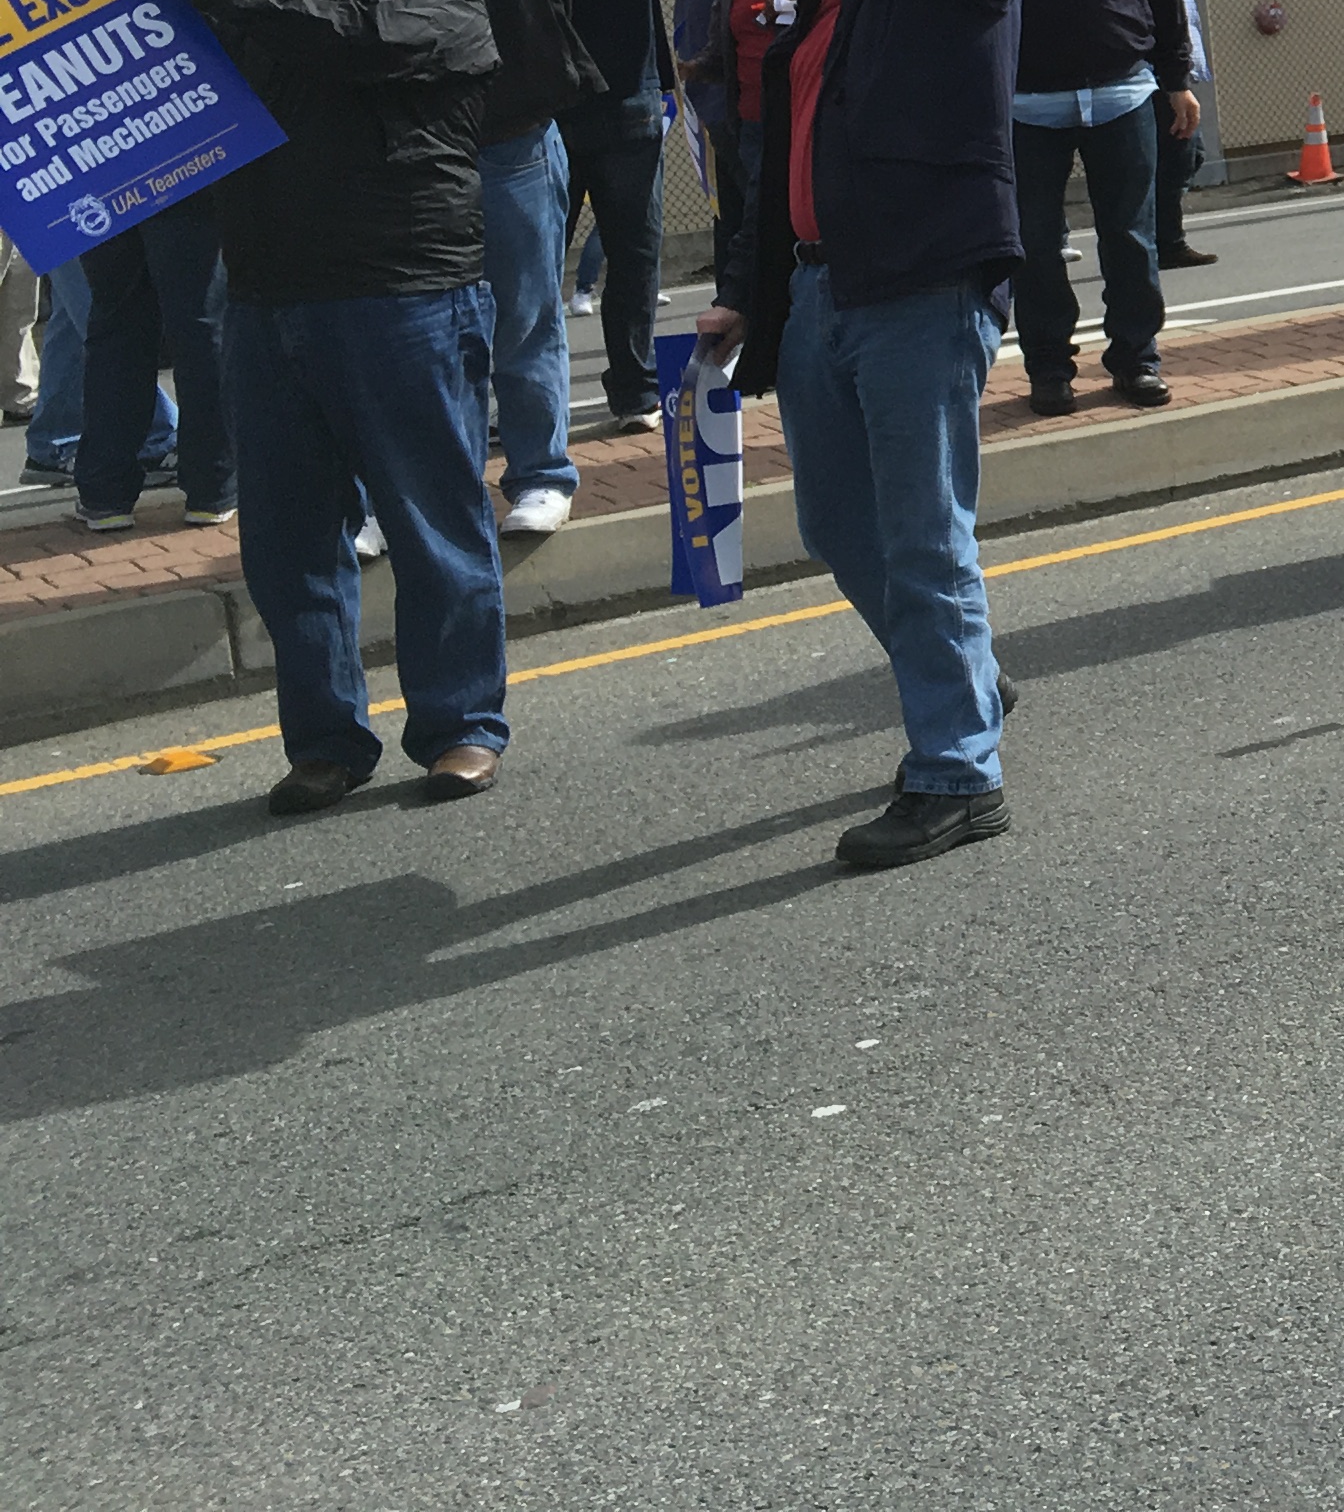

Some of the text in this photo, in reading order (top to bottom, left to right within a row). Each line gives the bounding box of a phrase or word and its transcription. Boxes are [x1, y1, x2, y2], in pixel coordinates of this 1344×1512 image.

[16, 82, 219, 202] and Mechanics
[34, 52, 197, 147] Passengers
[112, 144, 227, 216] UAL Teamsters
